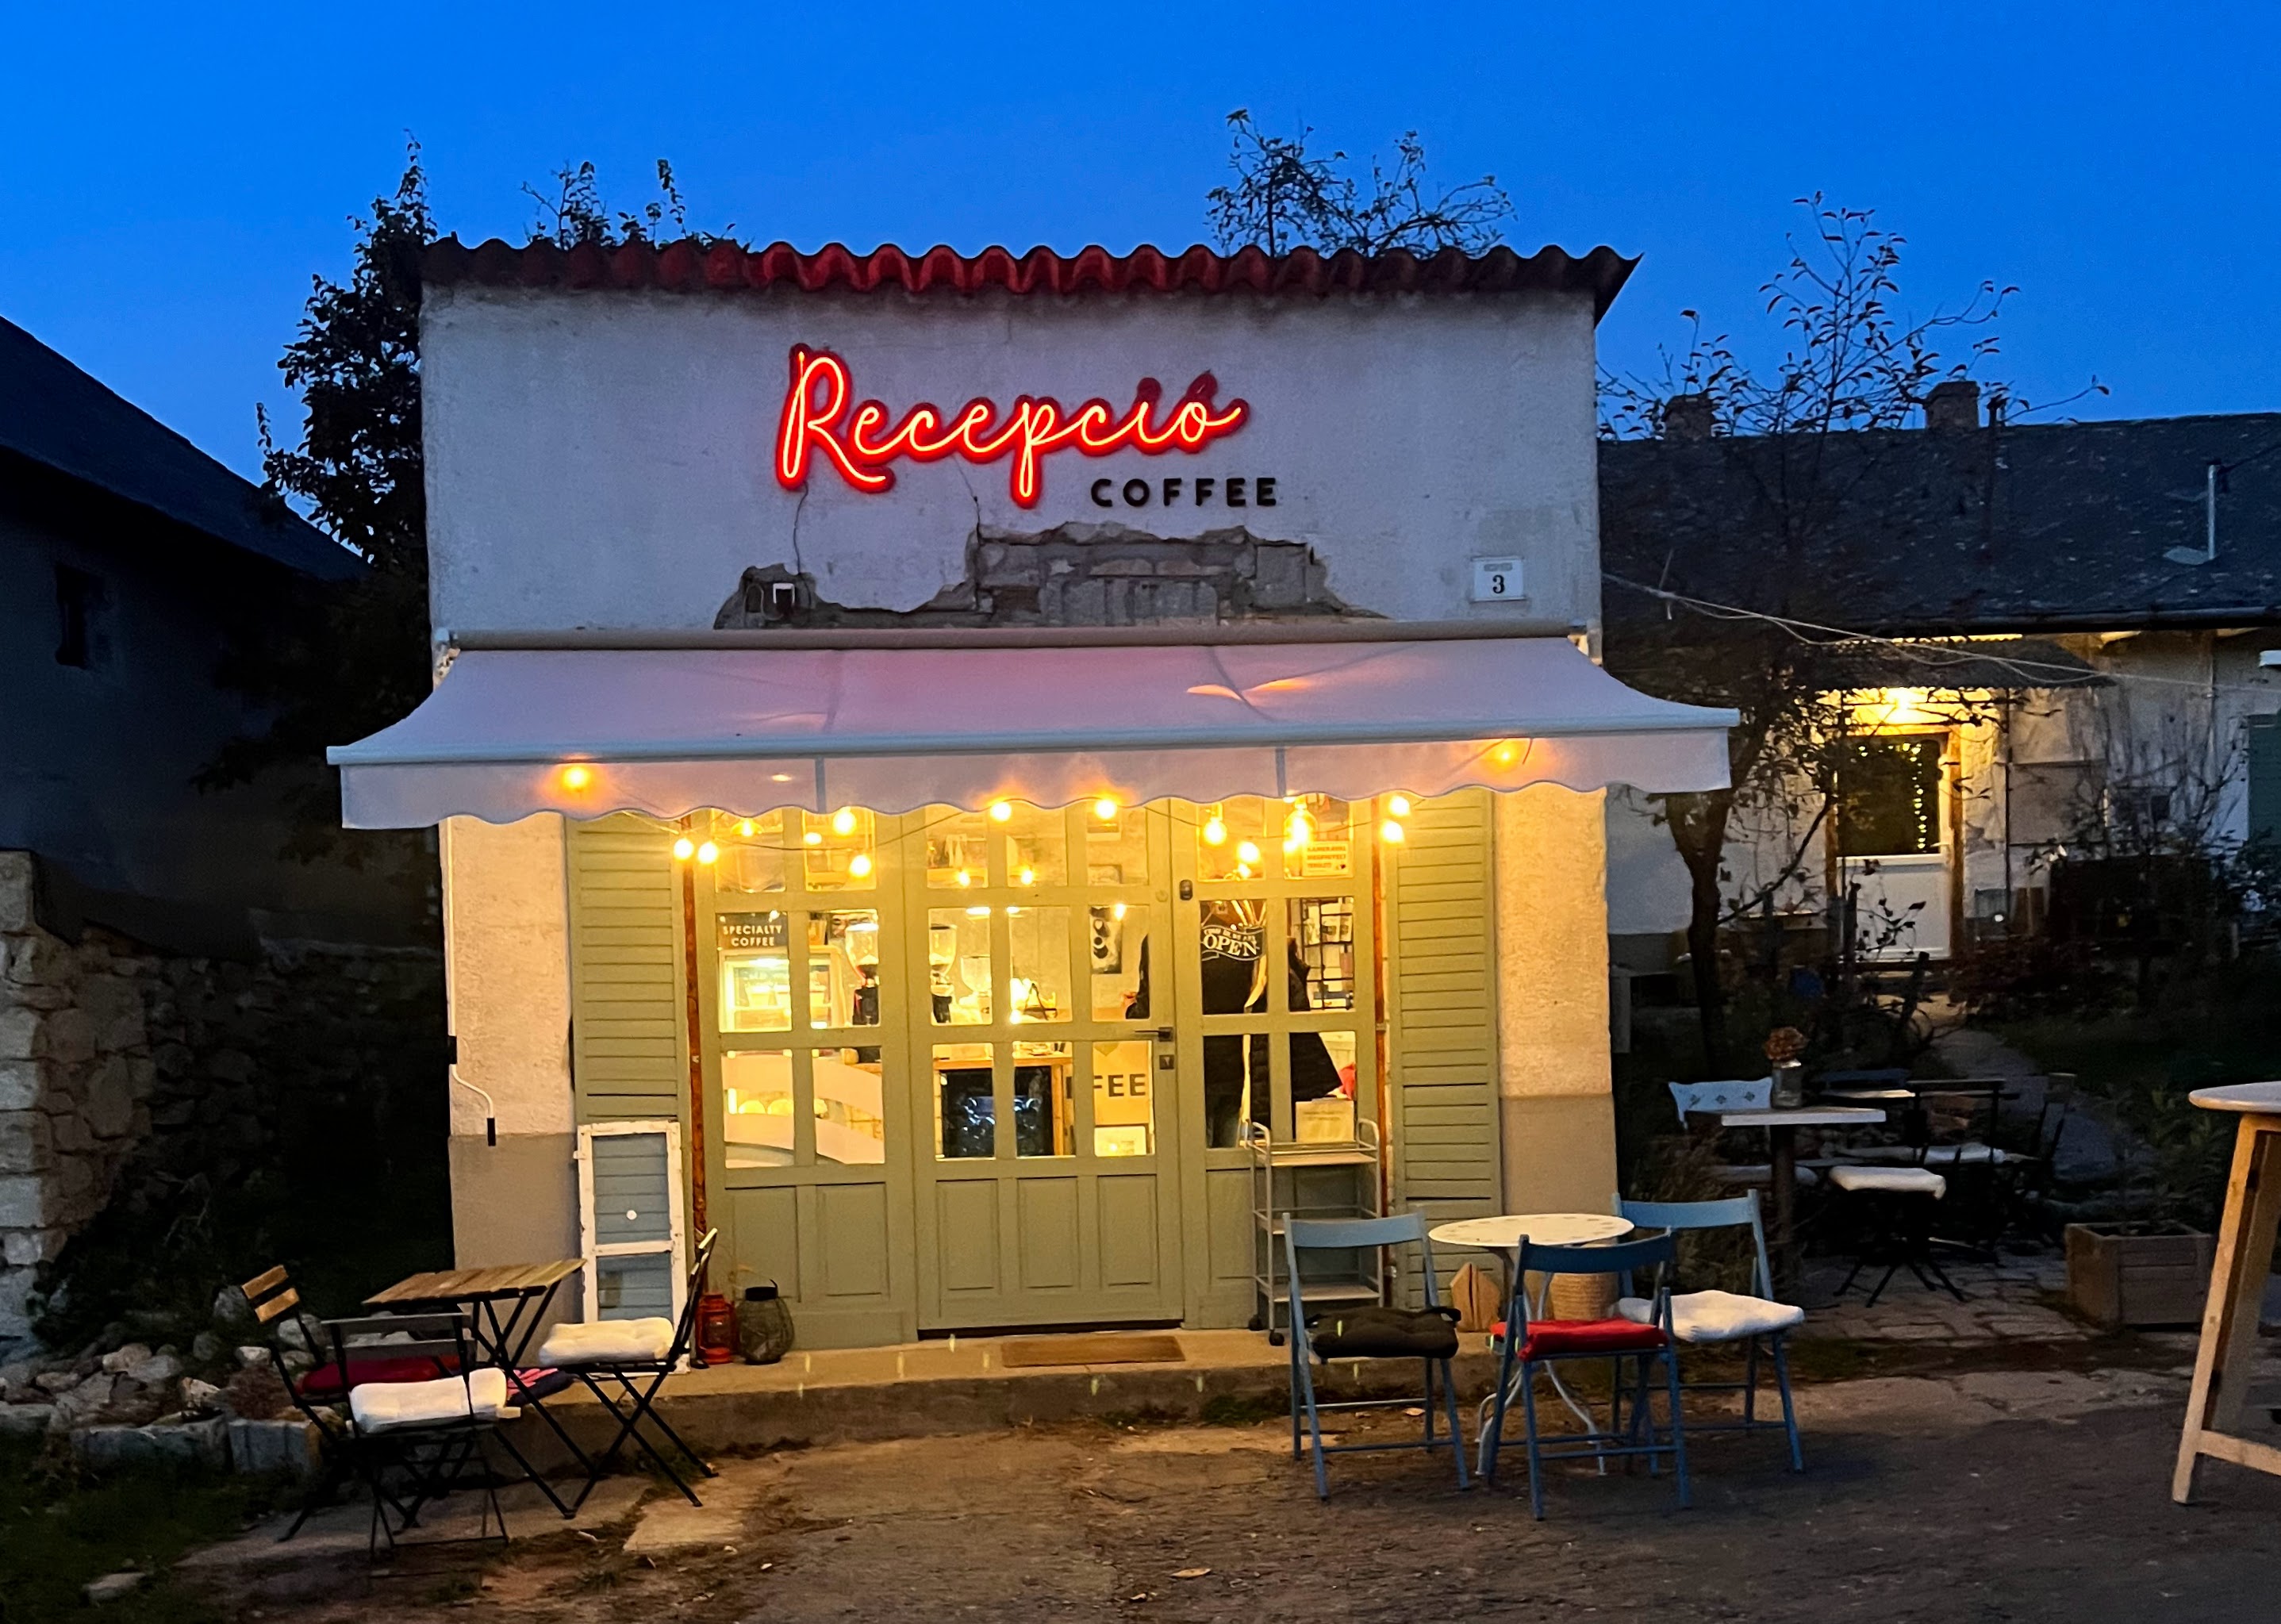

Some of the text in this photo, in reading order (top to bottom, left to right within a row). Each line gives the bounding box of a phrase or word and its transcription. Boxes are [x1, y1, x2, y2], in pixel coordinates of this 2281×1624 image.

[776, 344, 1249, 509] Recepció
[1090, 477, 1277, 508] COFFEE
[1492, 574, 1505, 594] 3
[723, 925, 782, 935] SPECIALTY
[731, 936, 775, 947] COFFEE
[1203, 934, 1257, 957] OPEN
